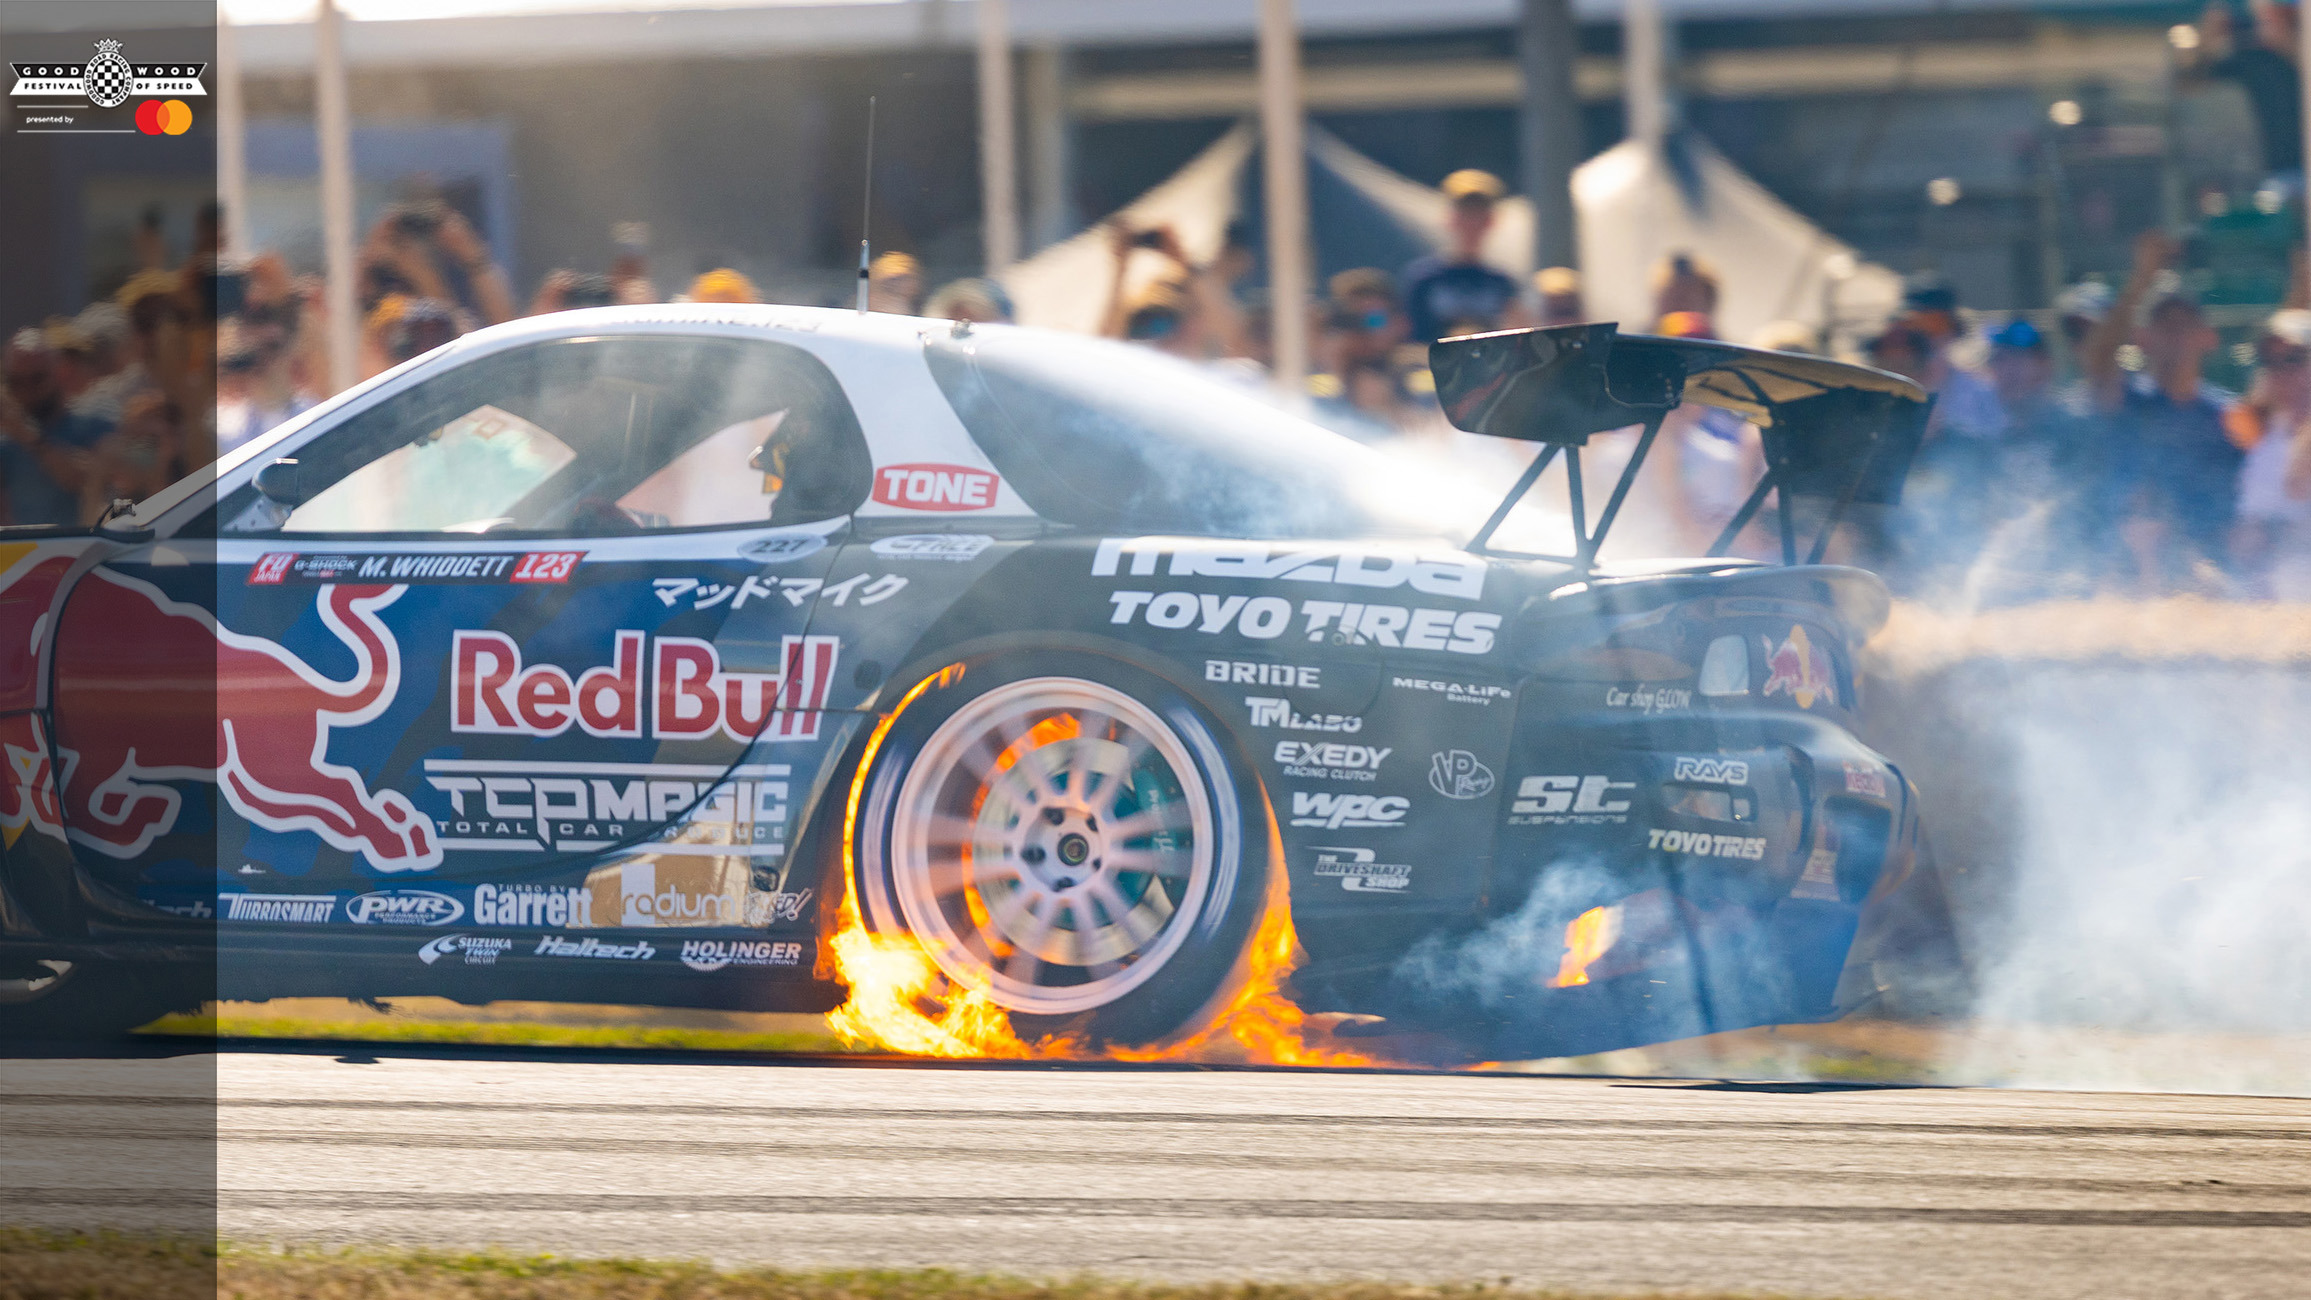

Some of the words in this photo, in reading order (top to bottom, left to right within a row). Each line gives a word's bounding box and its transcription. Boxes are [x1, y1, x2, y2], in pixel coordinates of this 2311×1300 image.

[883, 470, 991, 506] TONE
[358, 556, 386, 578] M.
[389, 556, 514, 577] WHIDDETT
[515, 553, 577, 579] 123
[652, 573, 909, 610] マッドマイク
[1109, 591, 1292, 639] TOYO
[1301, 600, 1502, 655] TIRES
[451, 629, 645, 737] Red
[652, 634, 840, 742] Bull
[1205, 660, 1321, 688] BRIDE
[1447, 693, 1491, 706] Battery
[1606, 687, 1630, 706] Car
[1274, 741, 1392, 769] EXEDY
[1284, 766, 1328, 778] RACING
[1330, 769, 1377, 781] CLUTCH
[1674, 757, 1749, 785] RAYS
[436, 820, 527, 834] TOTAL
[559, 823, 624, 836] CAR
[1648, 829, 1713, 856] TOYO
[1713, 834, 1767, 861] TIRES
[499, 883, 542, 892] TURBO
[474, 883, 594, 927] Garrett
[623, 884, 737, 918] radium
[458, 937, 512, 950] SUZUKA
[463, 949, 500, 957] TWIN
[534, 935, 656, 960] Haltech
[680, 940, 802, 960] HOLINGER
[732, 957, 799, 966] ENGINEERING
